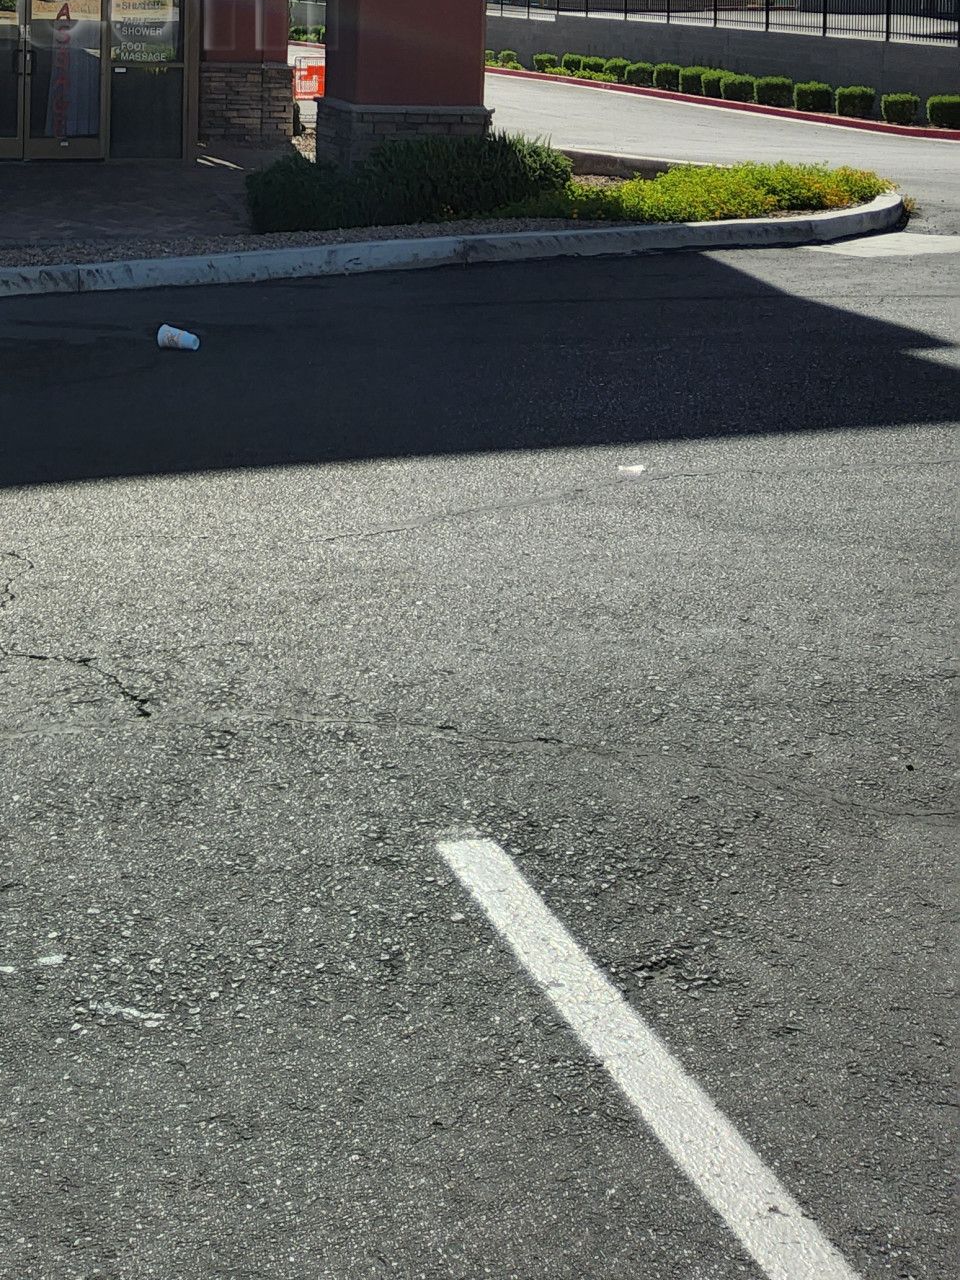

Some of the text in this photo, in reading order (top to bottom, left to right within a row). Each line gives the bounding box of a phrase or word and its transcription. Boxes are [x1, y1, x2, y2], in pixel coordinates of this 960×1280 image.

[121, 26, 163, 36] SHOWER
[121, 42, 147, 51] FOOT
[120, 52, 168, 61] MASSAGE
